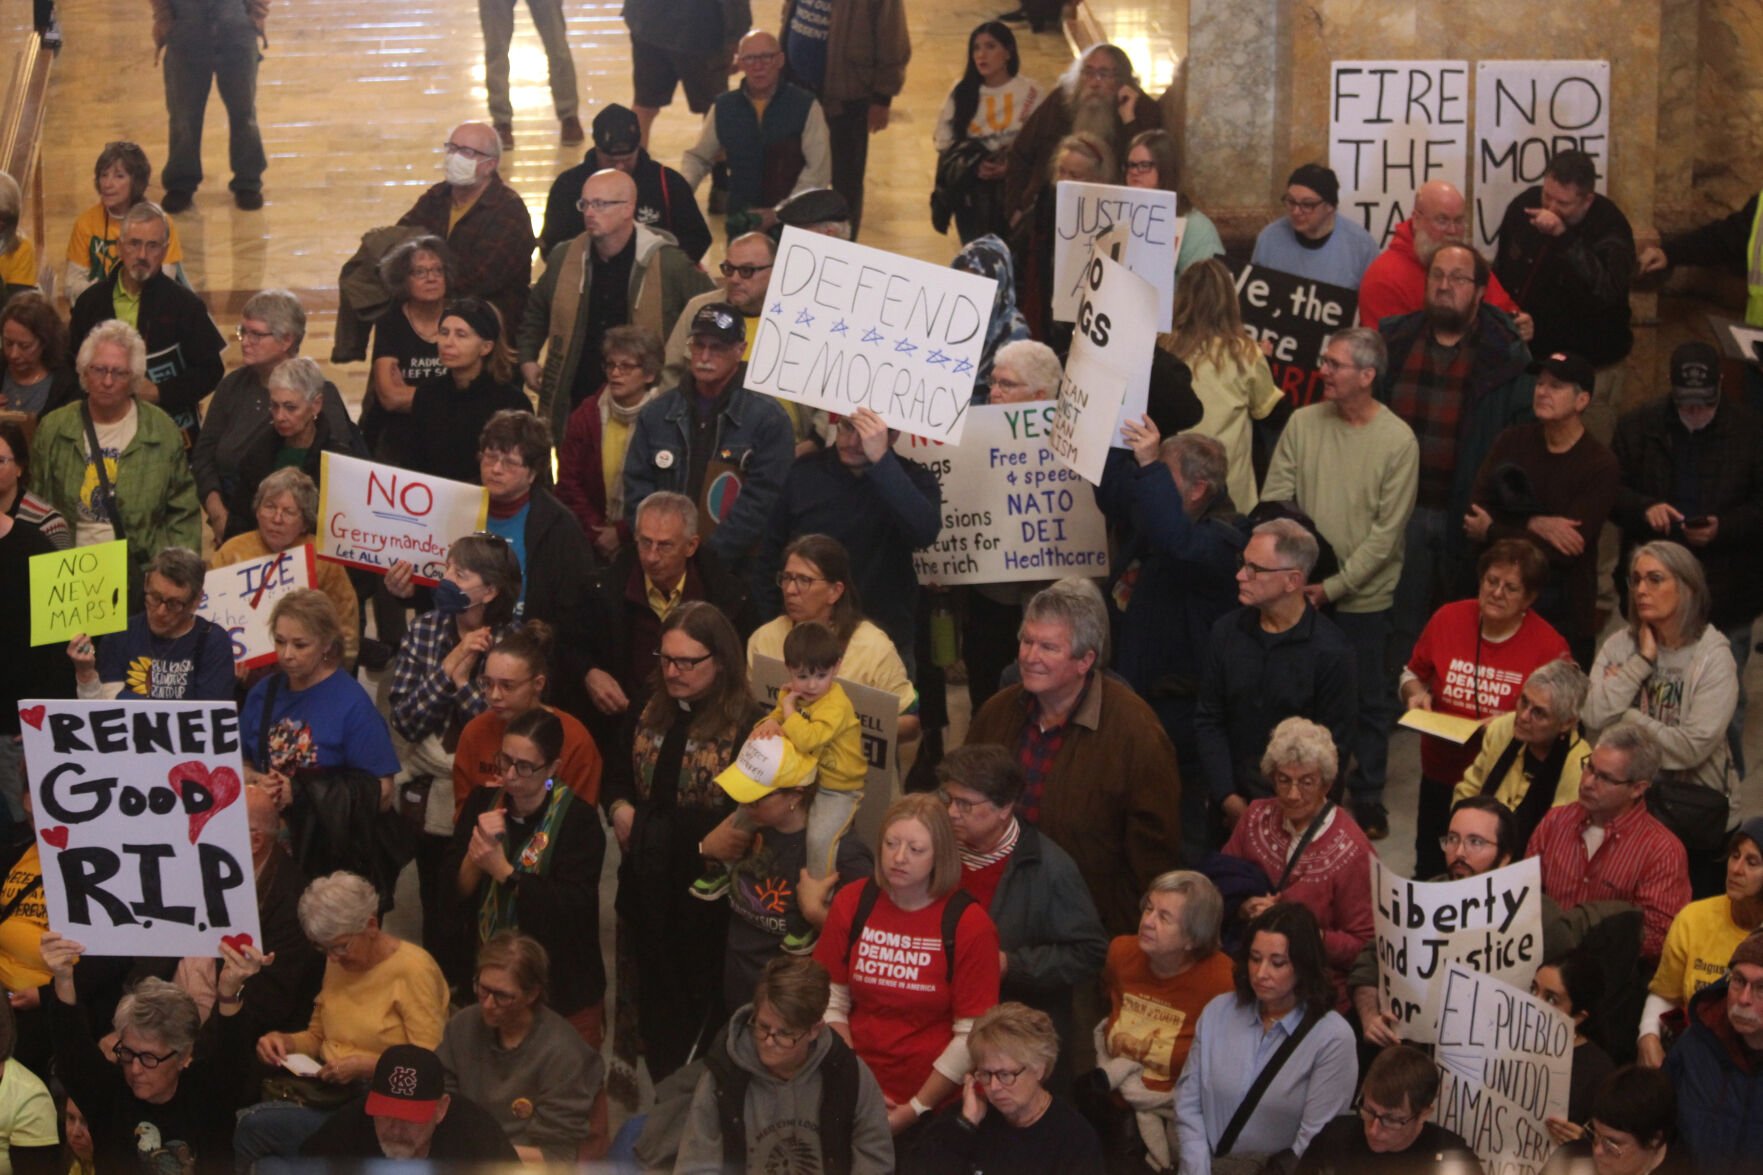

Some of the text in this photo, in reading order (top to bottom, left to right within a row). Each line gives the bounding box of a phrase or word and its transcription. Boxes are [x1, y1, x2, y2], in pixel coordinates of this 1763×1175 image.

[1335, 68, 1464, 124] FIRE
[1496, 77, 1602, 130] NO
[1337, 139, 1456, 193] THE
[1058, 196, 1167, 246] JUSTICE
[1355, 201, 1406, 249] TA
[781, 244, 980, 345] DEFEND
[1289, 284, 1343, 326] the
[410, 357, 443, 368] RADIC
[750, 317, 971, 436] DEMOCRACY
[1004, 407, 1057, 439] YES
[990, 448, 1028, 469] Free
[366, 470, 434, 517] NO
[1007, 489, 1074, 516] NATO
[330, 511, 452, 558] Gerrymander
[974, 532, 1000, 551] for
[1021, 518, 1068, 543] DEI
[57, 553, 98, 579] NO
[336, 544, 355, 560] Let
[358, 551, 382, 565] ALL
[914, 553, 979, 576] the rich
[1004, 547, 1107, 571] Healthcare
[47, 576, 105, 607] NEW
[236, 554, 295, 598] ICE
[1445, 671, 1511, 696] DEMAND
[1449, 658, 1495, 679] MOMS
[1442, 683, 1500, 708] ACTON
[48, 708, 239, 755] RENEE
[1376, 876, 1530, 934] Liberty
[861, 926, 912, 949] MOMS
[854, 958, 919, 981] ACTION
[858, 941, 932, 967] DEMAND
[1378, 931, 1534, 980] and Jstice
[906, 983, 936, 992] AMERICA
[1438, 969, 1568, 1058] EL PUEBLO
[1483, 1057, 1550, 1122] UNIDO
